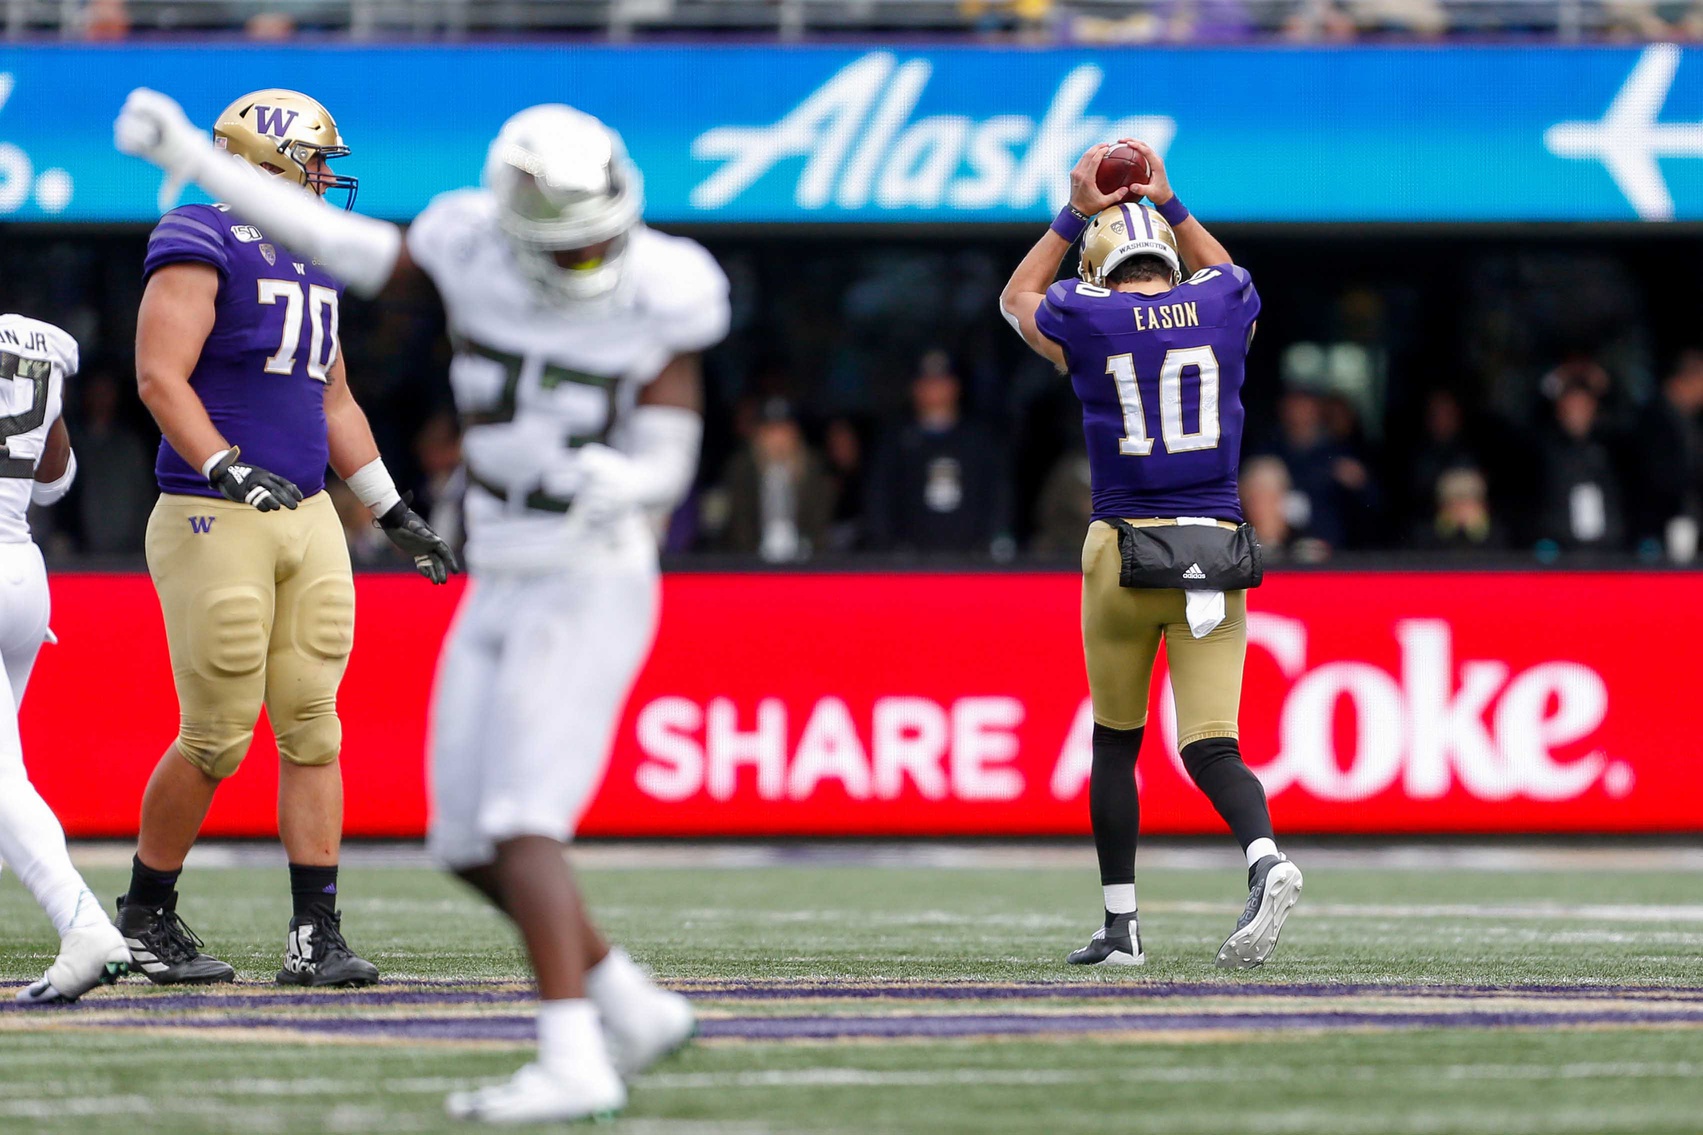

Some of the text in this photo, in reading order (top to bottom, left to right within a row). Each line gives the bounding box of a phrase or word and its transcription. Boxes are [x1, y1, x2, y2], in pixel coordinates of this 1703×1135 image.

[254, 105, 299, 138] W
[231, 225, 263, 243] 150
[1119, 241, 1168, 254] WASHINGTON
[292, 262, 306, 276] W
[1133, 301, 1200, 331] EASON
[25, 331, 48, 353] JR
[257, 278, 339, 383] 70
[1104, 344, 1220, 456] 10
[187, 515, 216, 534] W
[635, 695, 1026, 802] SHARE
